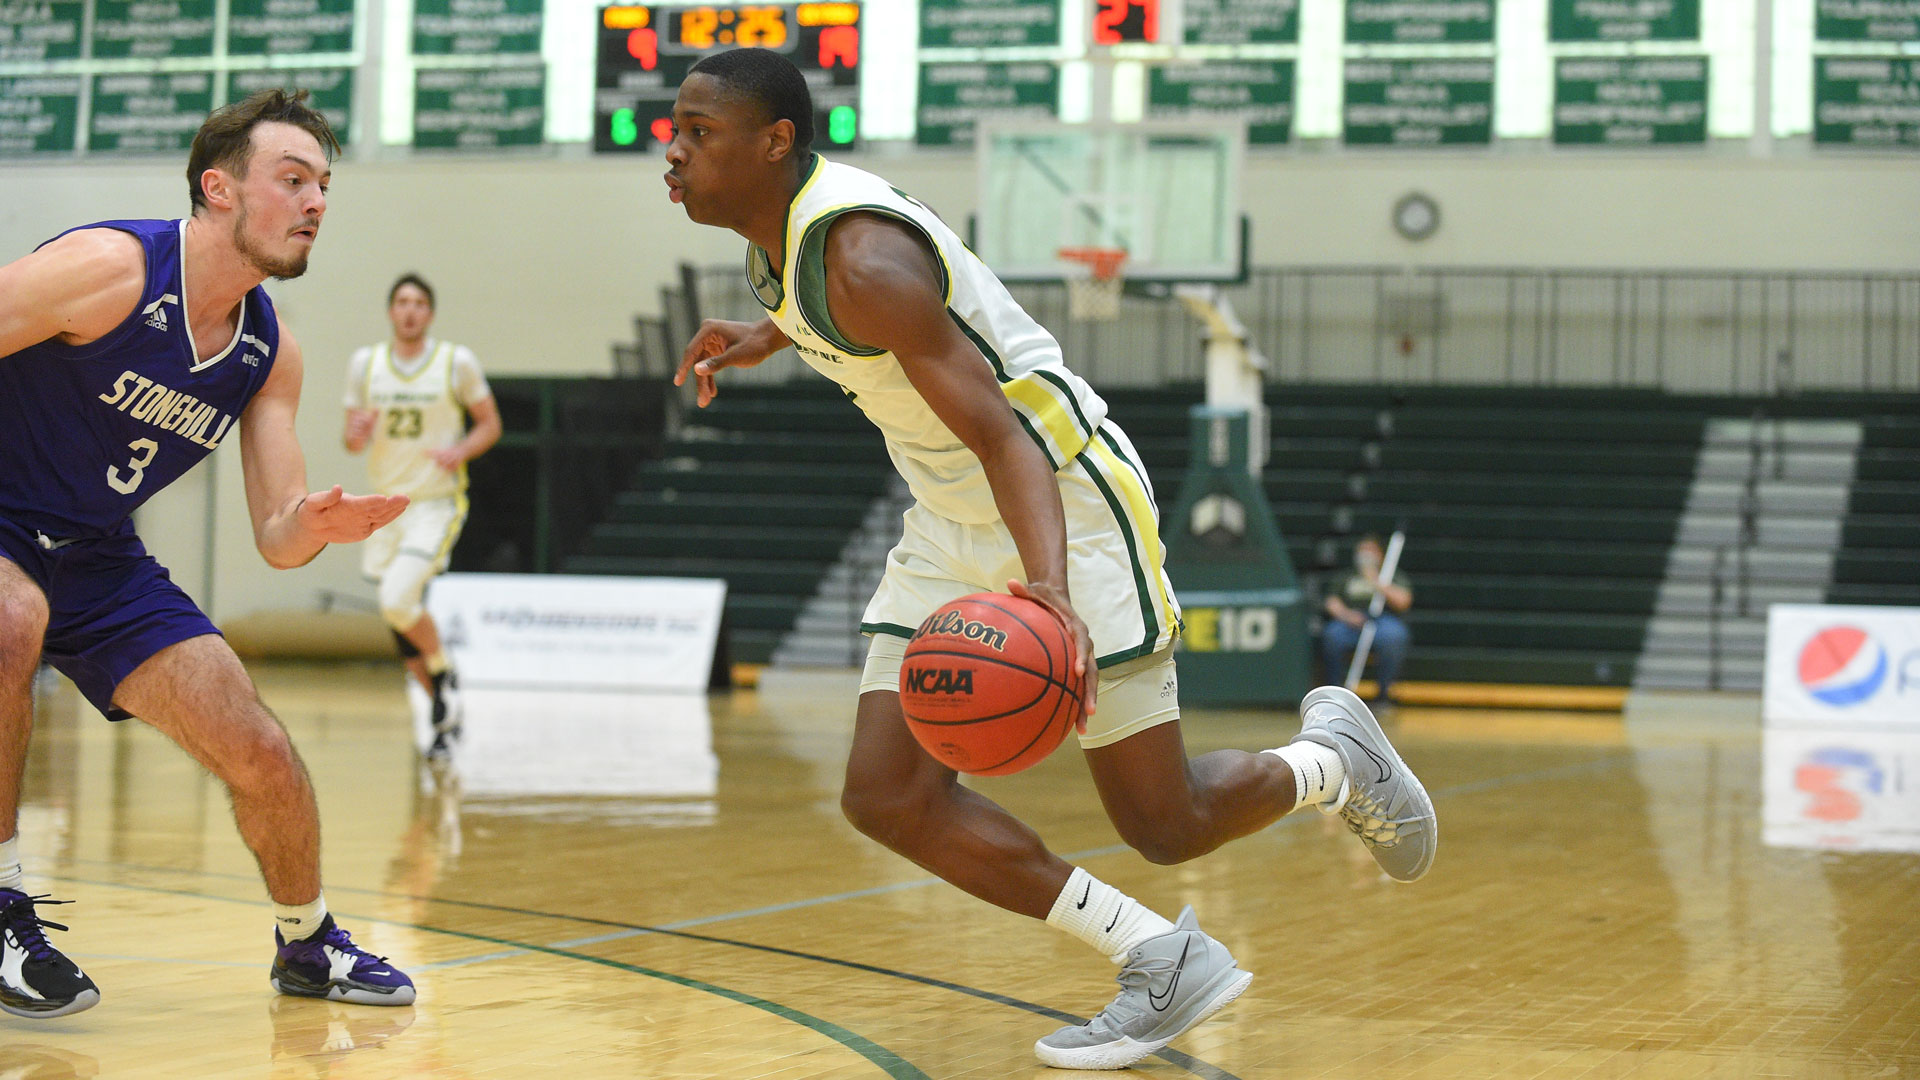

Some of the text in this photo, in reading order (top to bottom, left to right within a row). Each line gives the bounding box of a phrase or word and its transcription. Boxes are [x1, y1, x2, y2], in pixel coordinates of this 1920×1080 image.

[611, 107, 638, 146] 6
[98, 370, 232, 450] STONEHILL
[387, 406, 423, 439] 23
[106, 437, 159, 495] 3
[1177, 607, 1277, 653] E10
[905, 667, 974, 695] NCAA
